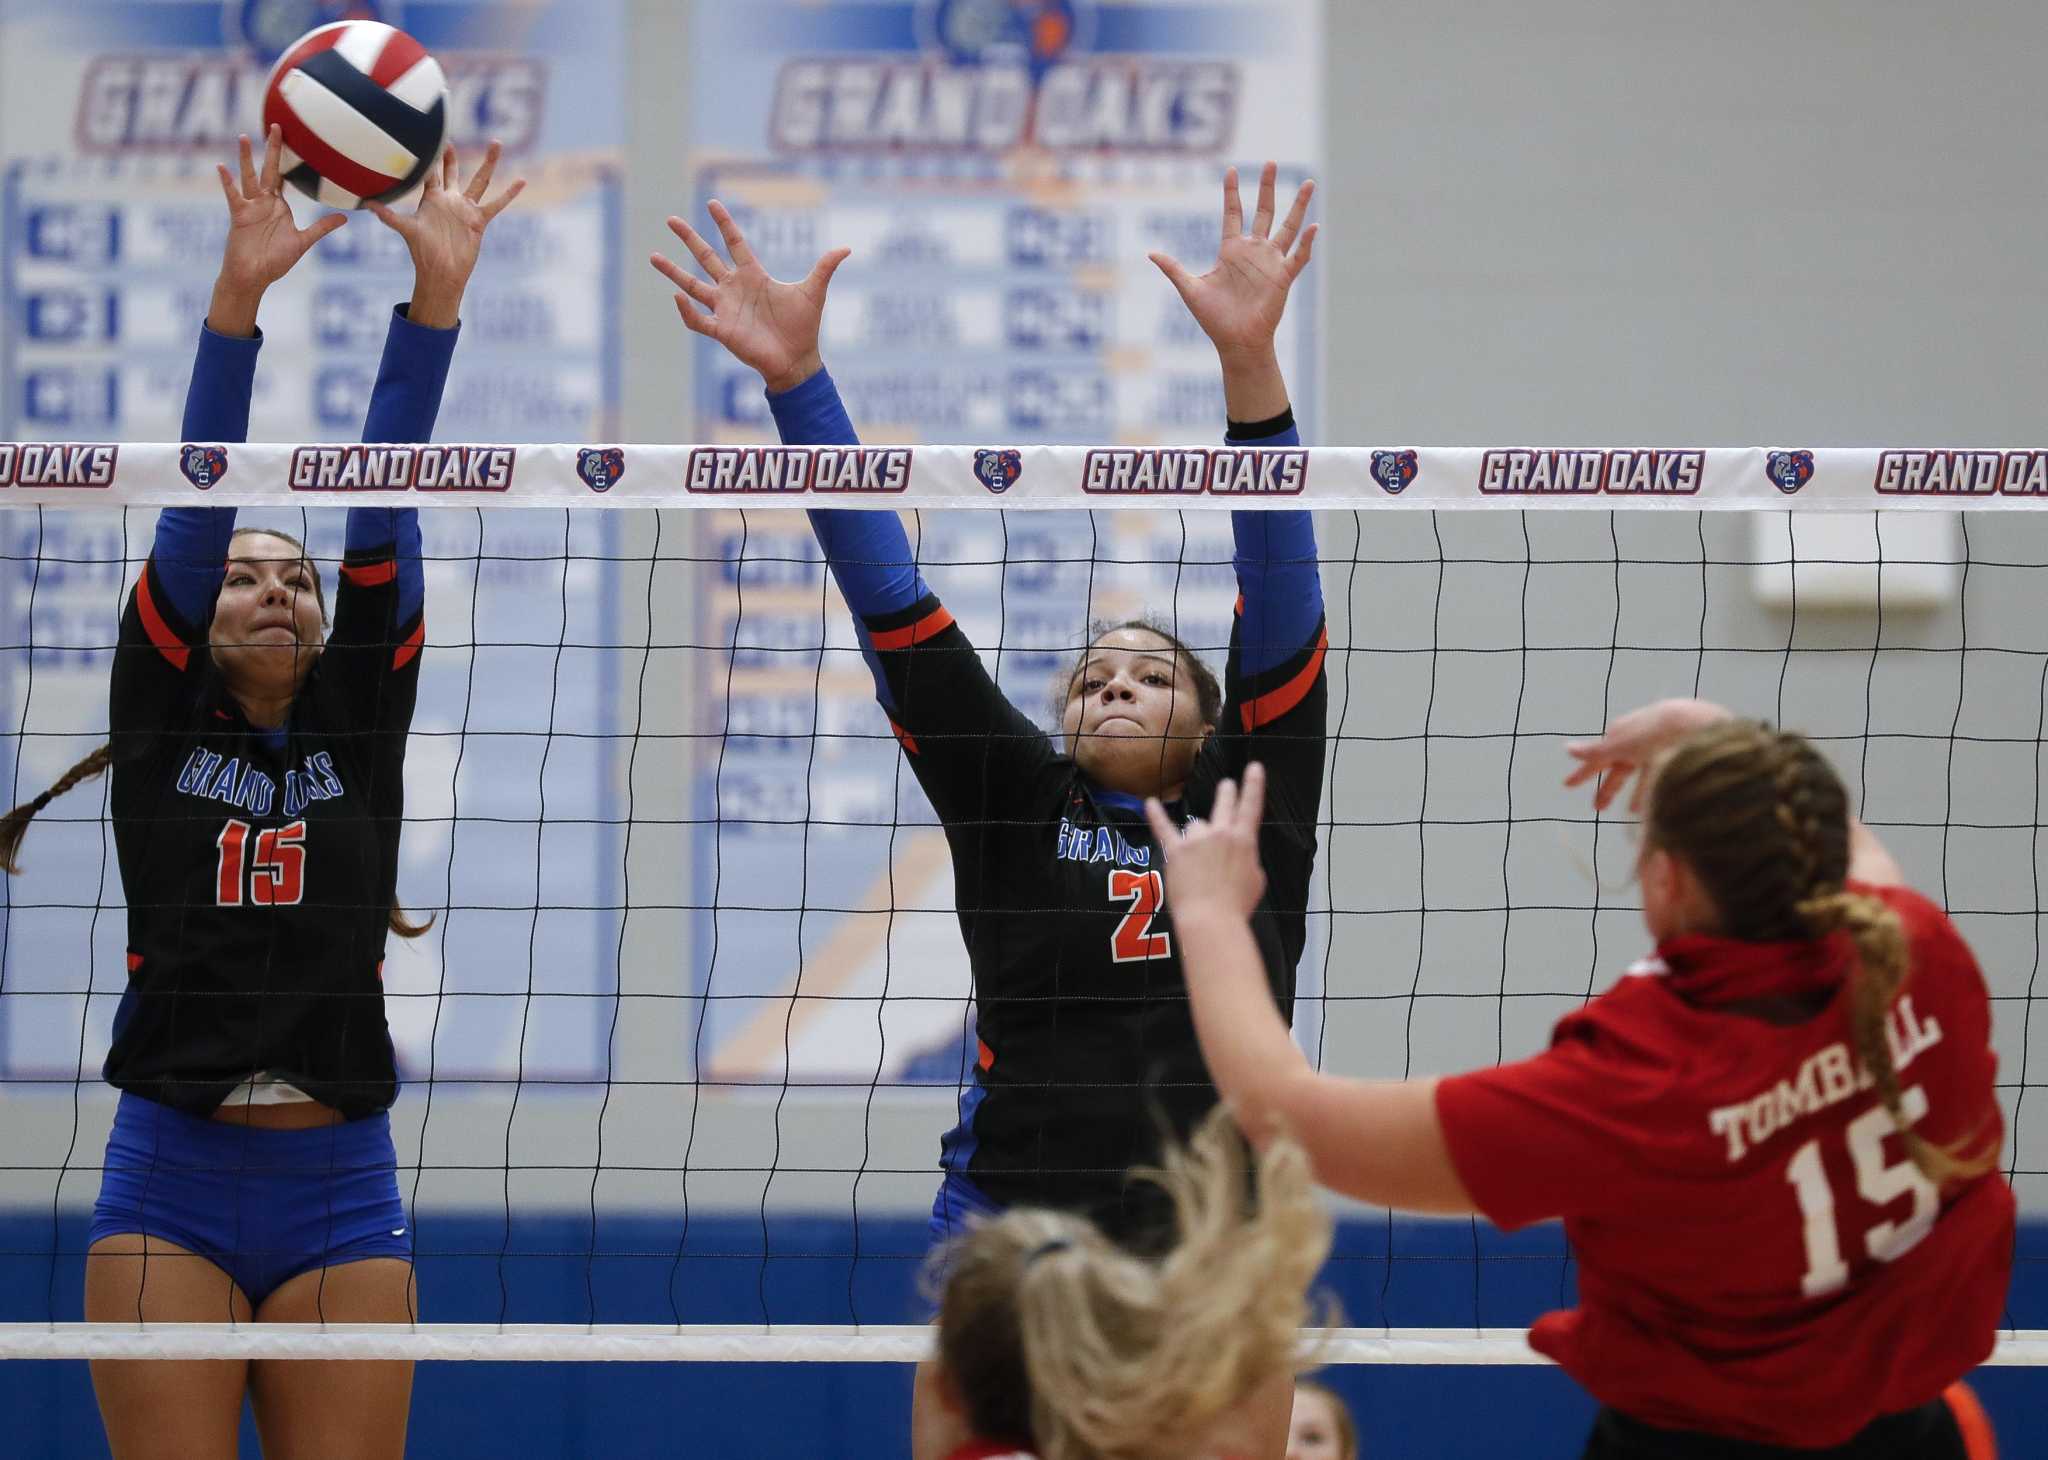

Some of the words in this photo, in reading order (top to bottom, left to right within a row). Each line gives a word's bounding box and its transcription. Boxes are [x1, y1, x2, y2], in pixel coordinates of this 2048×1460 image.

[19, 446, 114, 485] OAKS
[292, 448, 412, 488] GRAND
[417, 448, 512, 489] OAKS
[689, 450, 810, 489] GRAND
[814, 450, 909, 489] OAKS
[1086, 452, 1206, 490] GRAND
[1210, 453, 1305, 491] OAKS
[1482, 452, 1603, 490] GRAND
[1607, 452, 1702, 491] OAKS
[1878, 453, 2000, 491] GRAND
[177, 746, 276, 817] GRAND
[216, 818, 307, 907] 15
[1108, 869, 1171, 963] 2
[1786, 1085, 1940, 1297] 15
